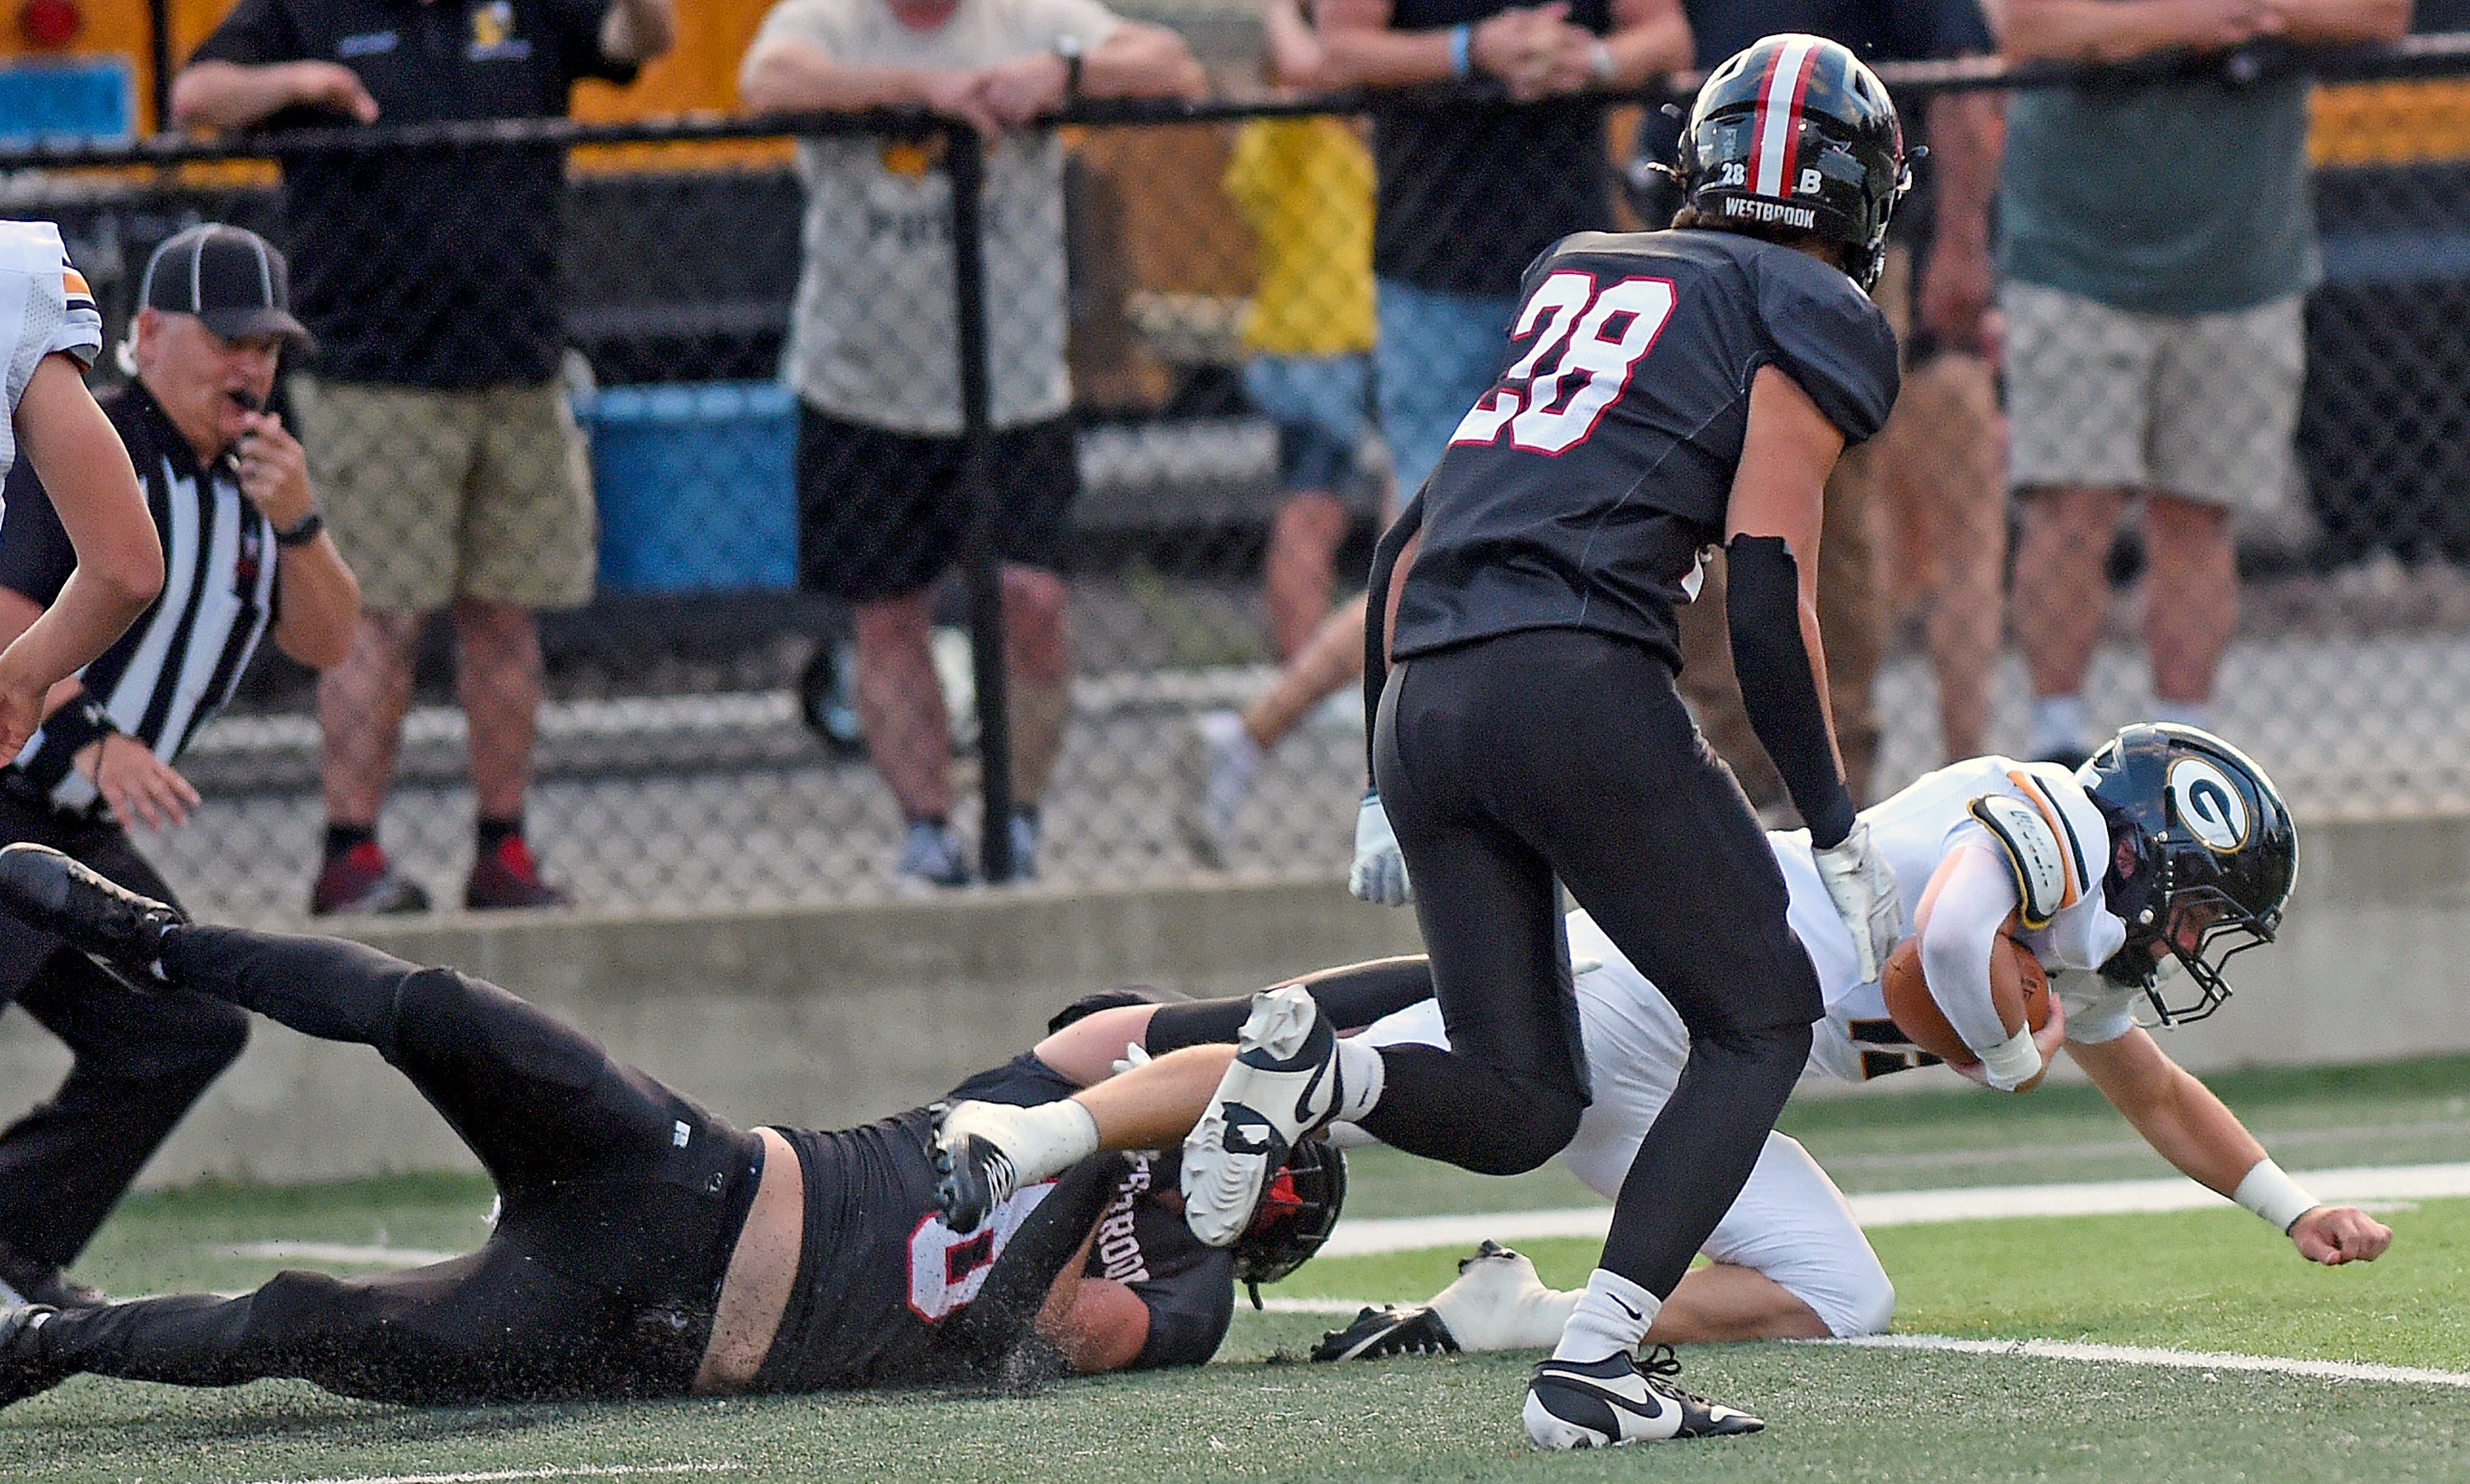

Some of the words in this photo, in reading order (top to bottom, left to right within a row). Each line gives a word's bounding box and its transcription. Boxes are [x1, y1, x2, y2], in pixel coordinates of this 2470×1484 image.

[1722, 163, 1745, 185] 28
[1799, 169, 1822, 193] B
[1726, 197, 1816, 229] WESTBROOK
[1447, 269, 1678, 456] 28
[2171, 760, 2247, 849] G
